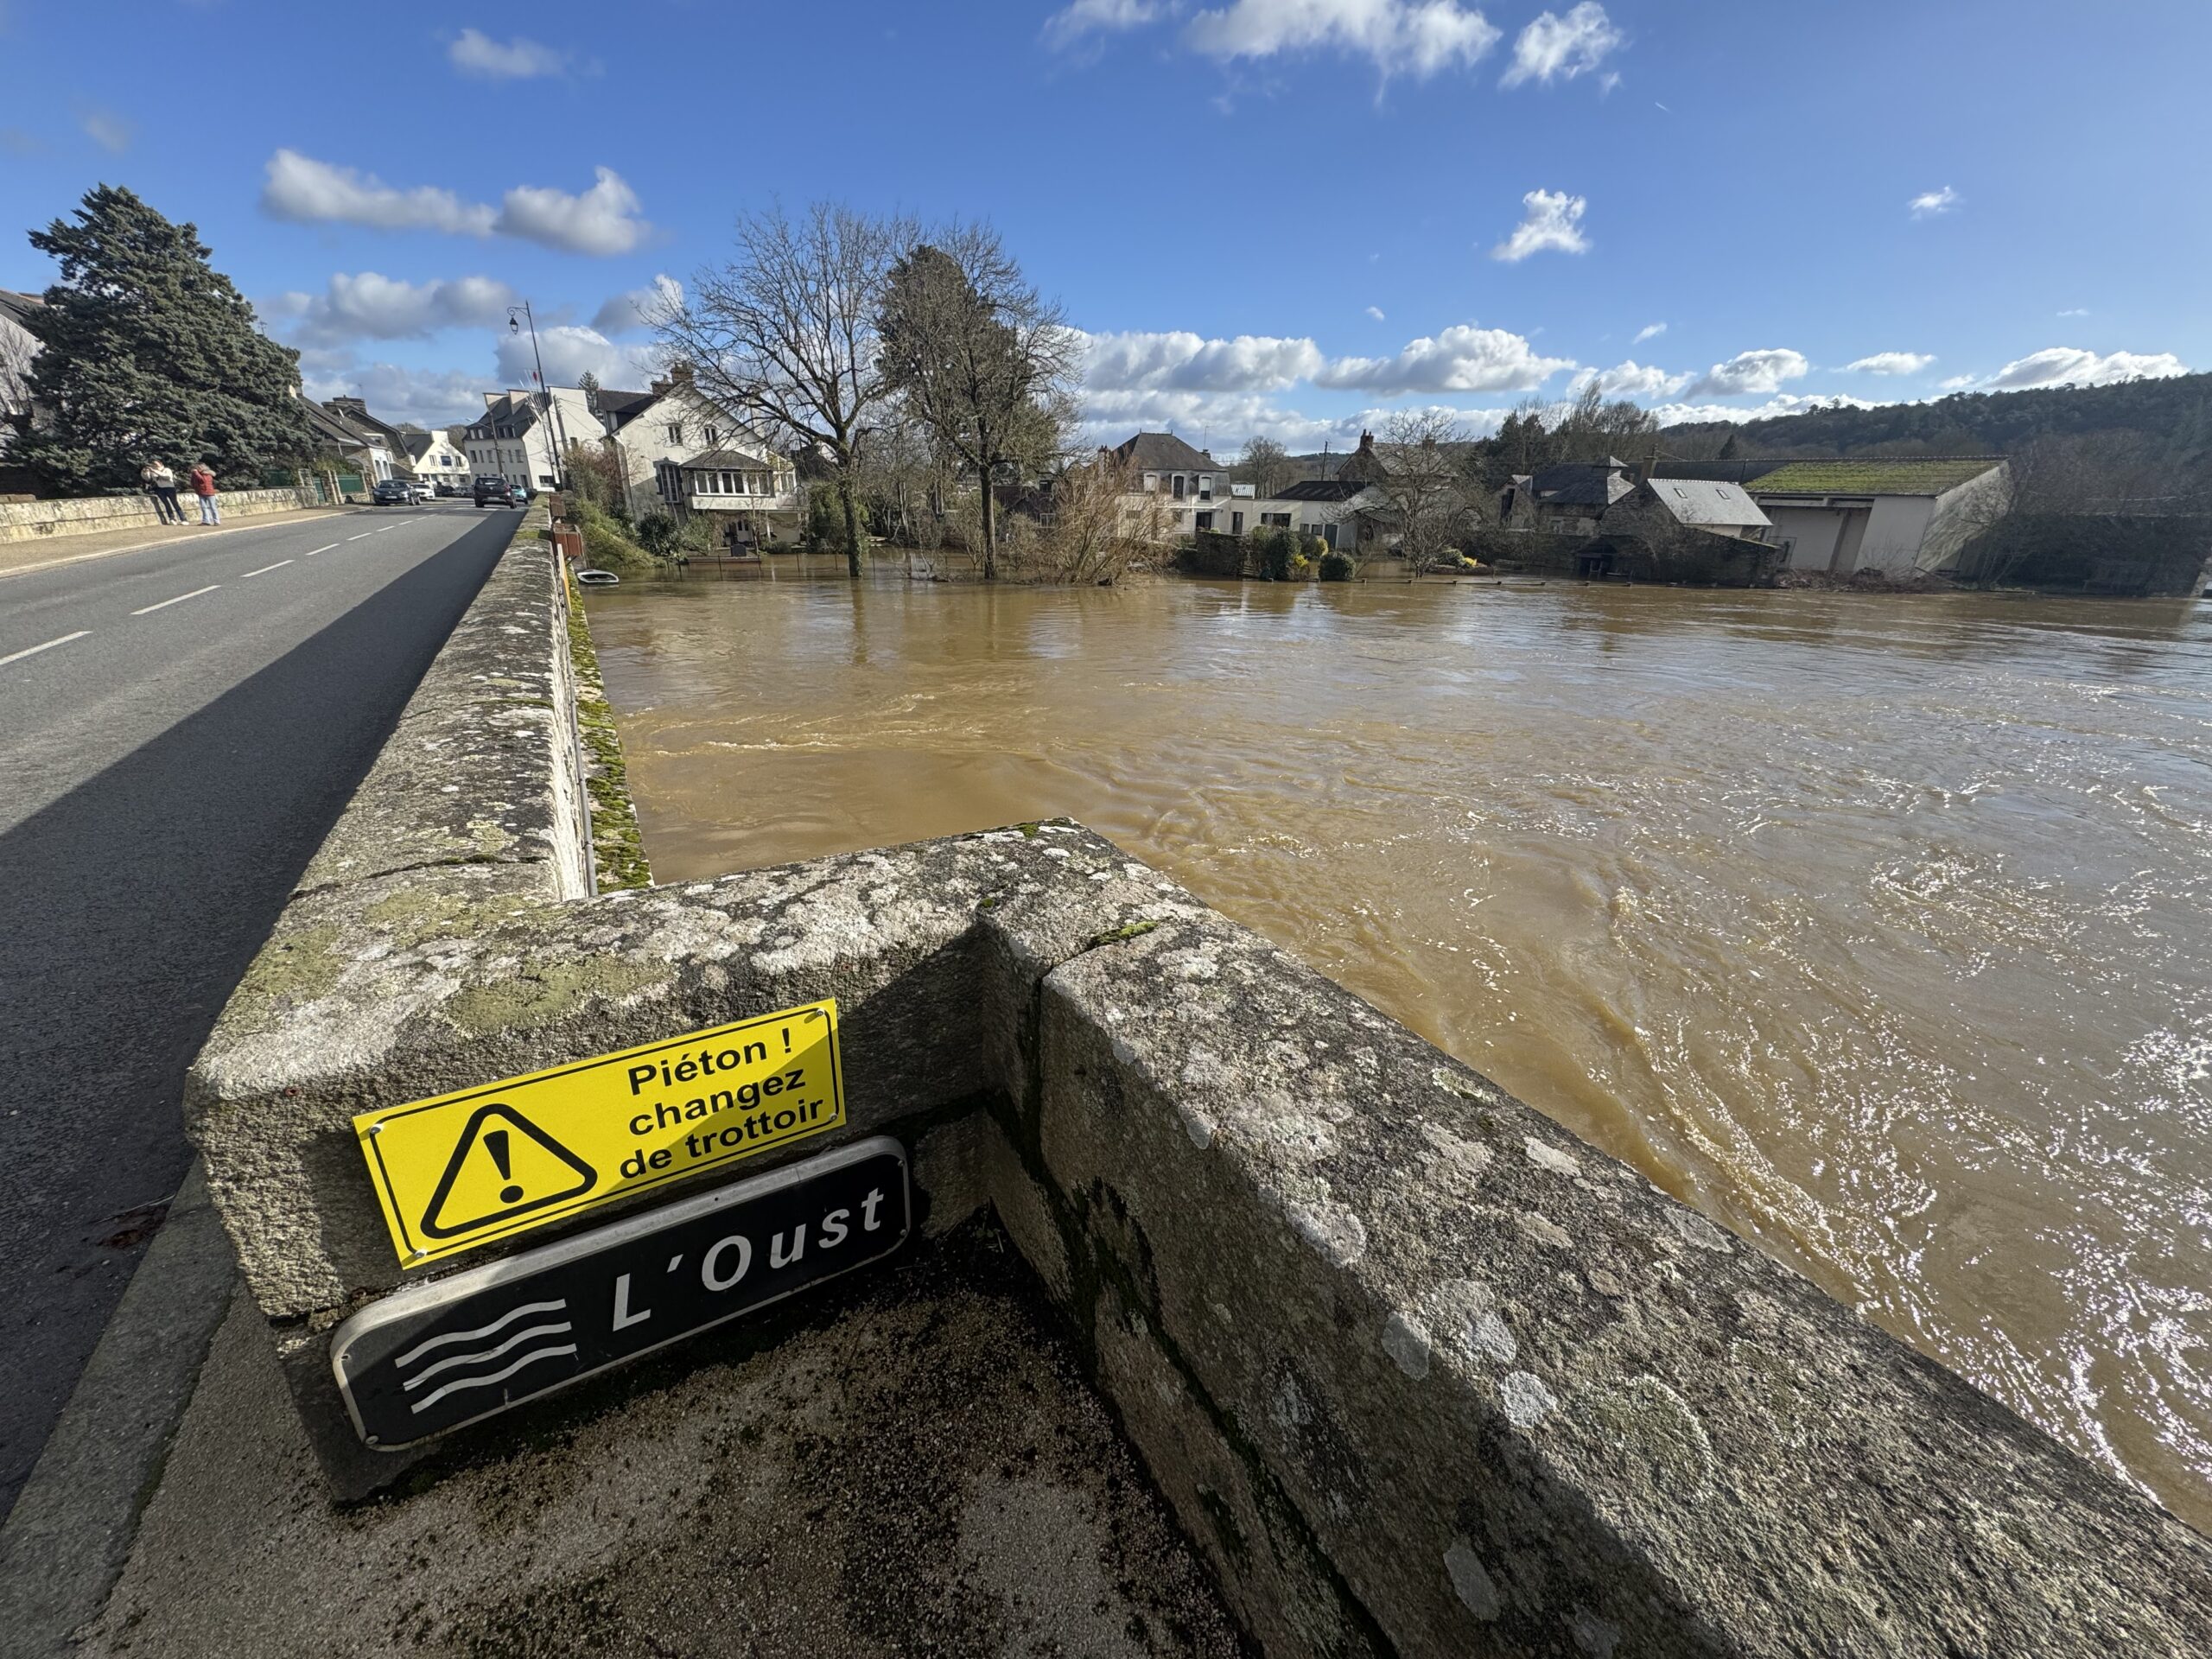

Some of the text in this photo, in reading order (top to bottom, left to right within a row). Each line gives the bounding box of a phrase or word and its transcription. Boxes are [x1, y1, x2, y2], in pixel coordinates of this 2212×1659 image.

[628, 1040, 767, 1096] Piéton
[629, 1068, 805, 1136] changez
[620, 1097, 824, 1179] de trottoir
[612, 1187, 885, 1332] L'Oust
